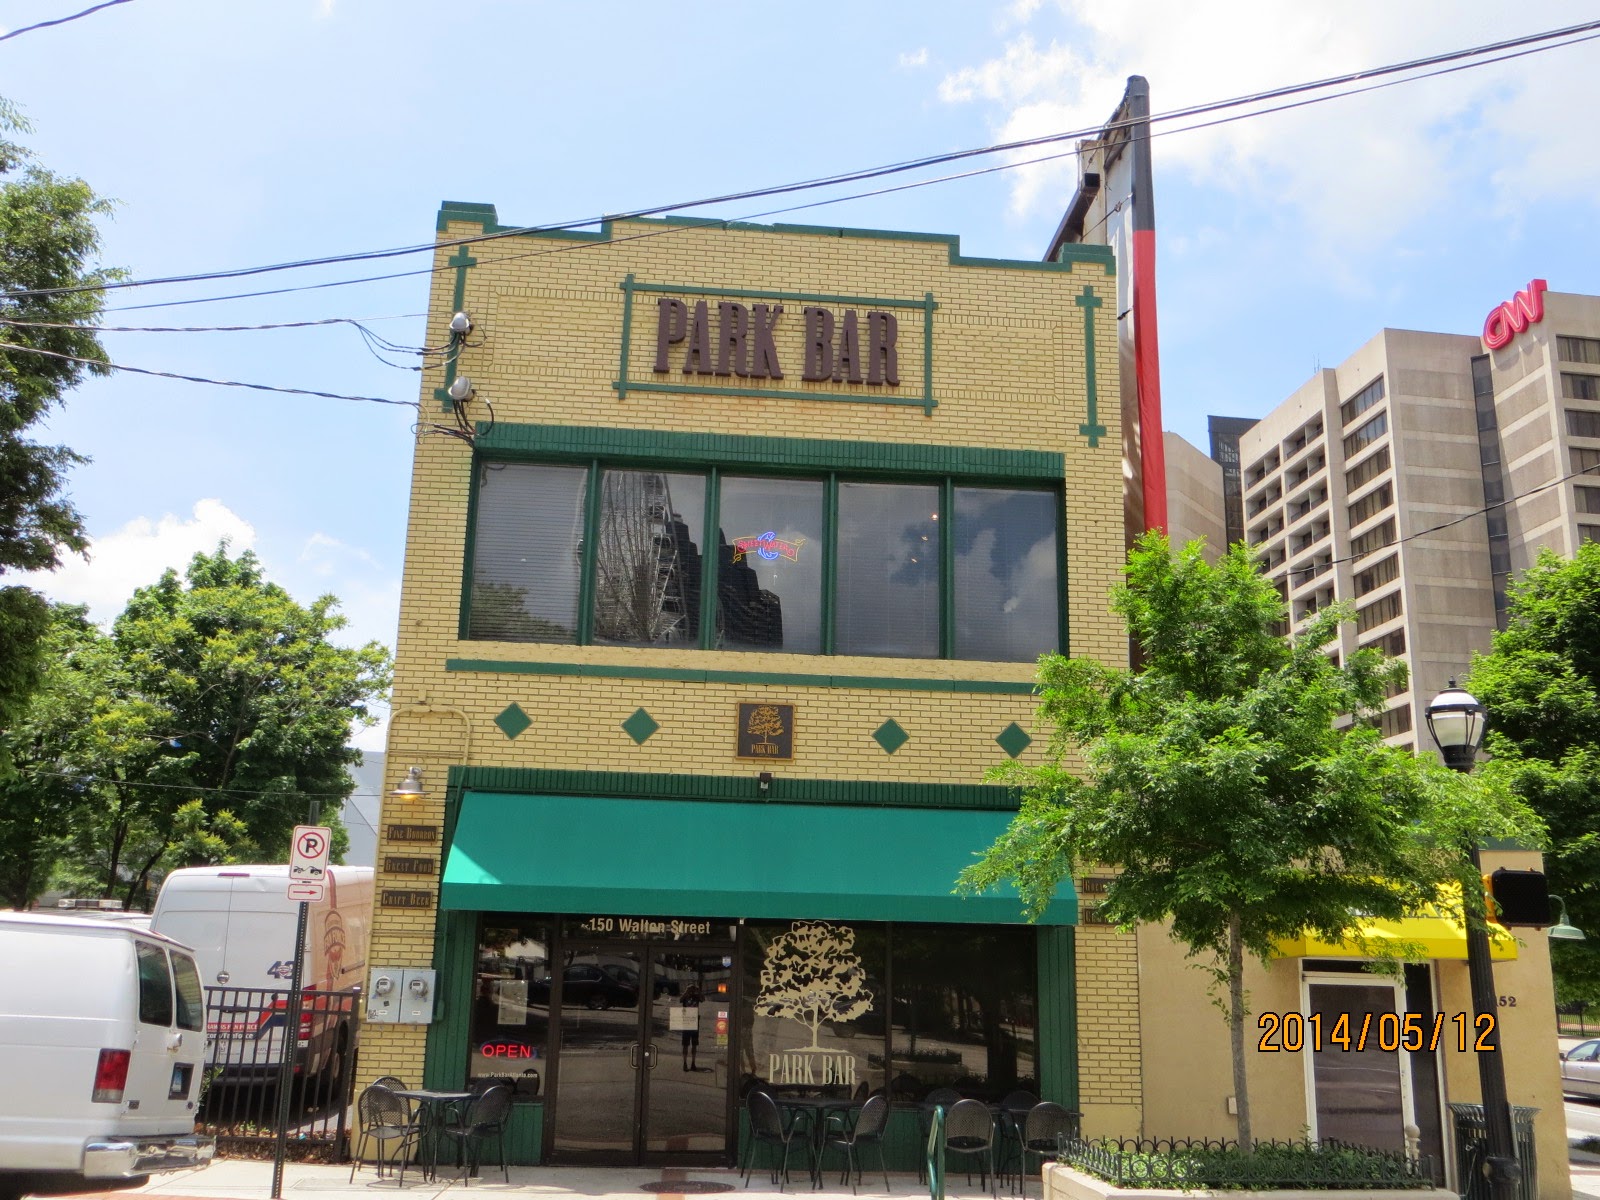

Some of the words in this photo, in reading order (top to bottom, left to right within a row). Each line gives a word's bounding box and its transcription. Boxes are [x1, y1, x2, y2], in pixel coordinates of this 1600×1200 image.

[1483, 278, 1547, 350] CNN
[653, 297, 784, 380] PARK
[802, 306, 900, 387] BAR
[751, 743, 766, 754] PARK
[767, 744, 779, 755] BAR
[385, 858, 410, 872] GREAT
[590, 917, 614, 932] 150
[619, 918, 665, 934] Walton
[670, 919, 711, 935] Street
[1495, 995, 1517, 1008] 52
[481, 1043, 532, 1059] OPEN
[769, 1053, 816, 1085] PARK
[822, 1055, 856, 1086] BAR
